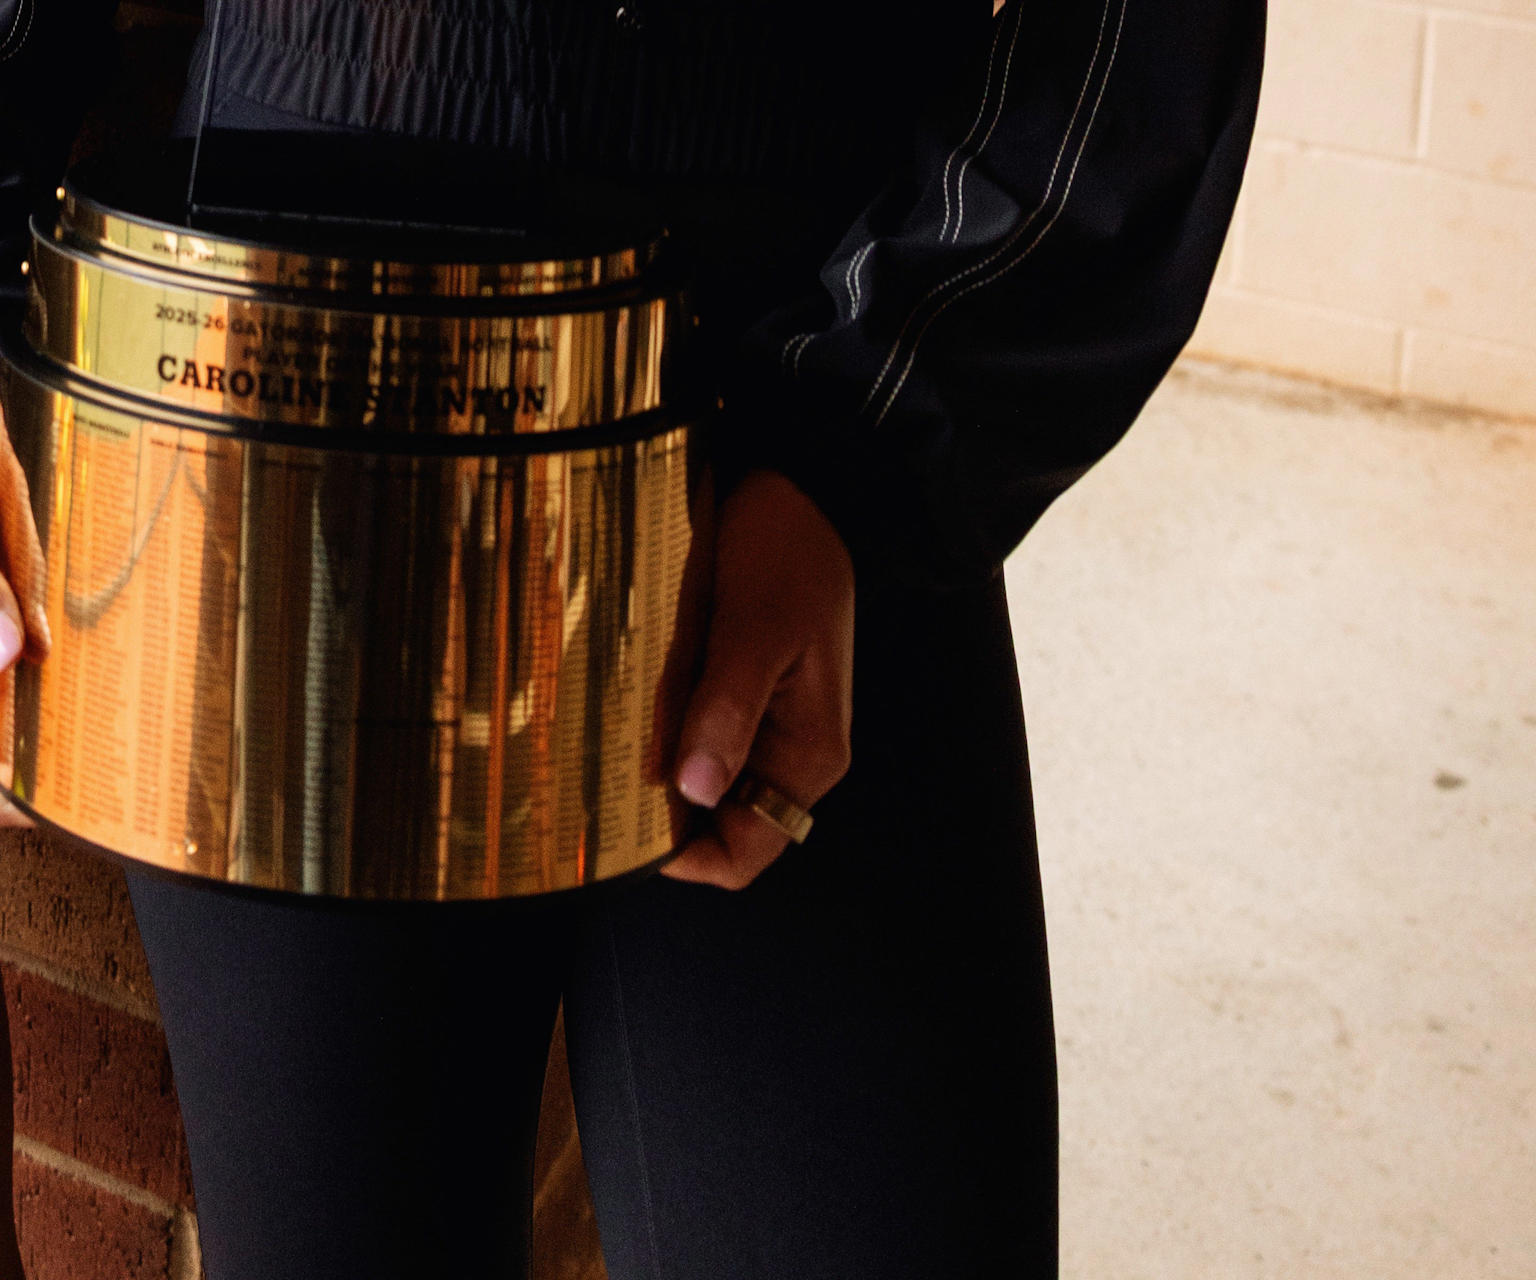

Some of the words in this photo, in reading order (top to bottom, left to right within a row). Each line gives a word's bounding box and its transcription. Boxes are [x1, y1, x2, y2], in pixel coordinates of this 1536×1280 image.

[155, 304, 224, 330] 2025-26
[157, 355, 352, 411] CAROLINE
[360, 384, 545, 415] STANTON
